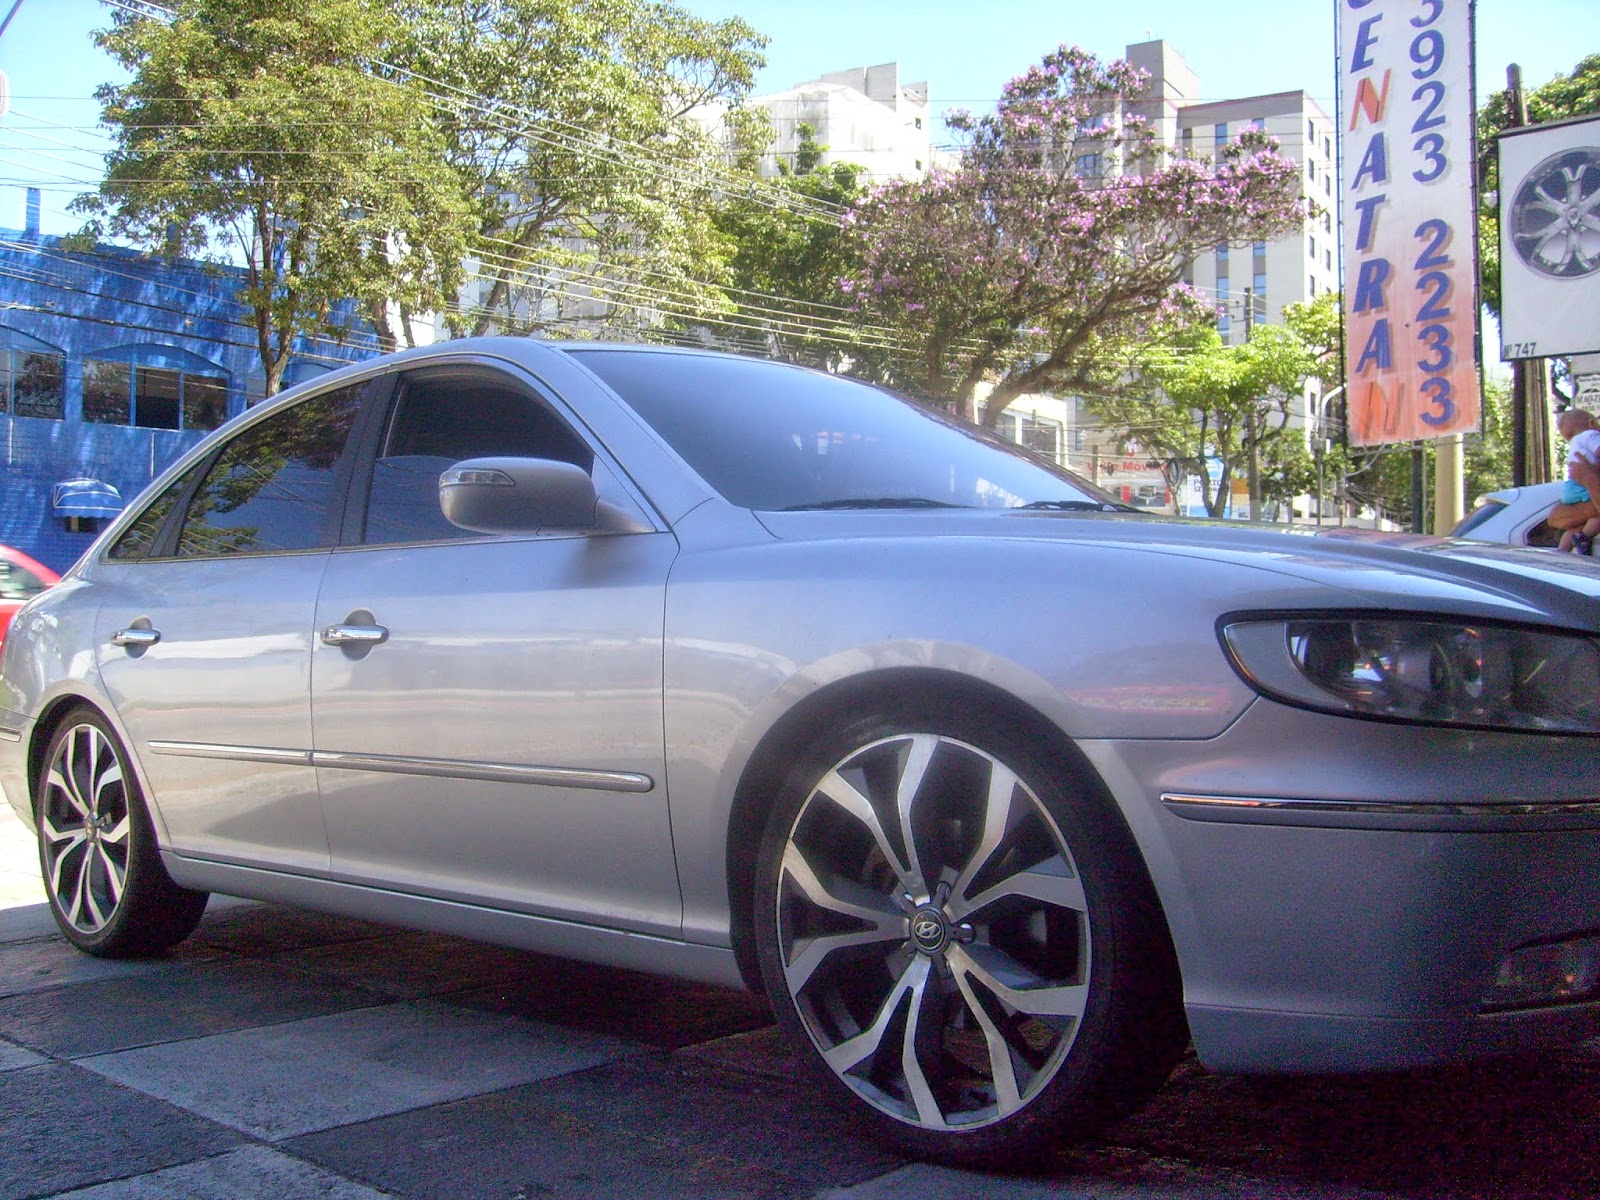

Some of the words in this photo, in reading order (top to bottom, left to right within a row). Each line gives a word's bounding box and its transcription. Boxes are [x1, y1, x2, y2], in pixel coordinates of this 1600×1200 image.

[1346, 0, 1403, 438] ENATRAN
[1413, 218, 1455, 426] 2233
[1514, 341, 1537, 357] 747
